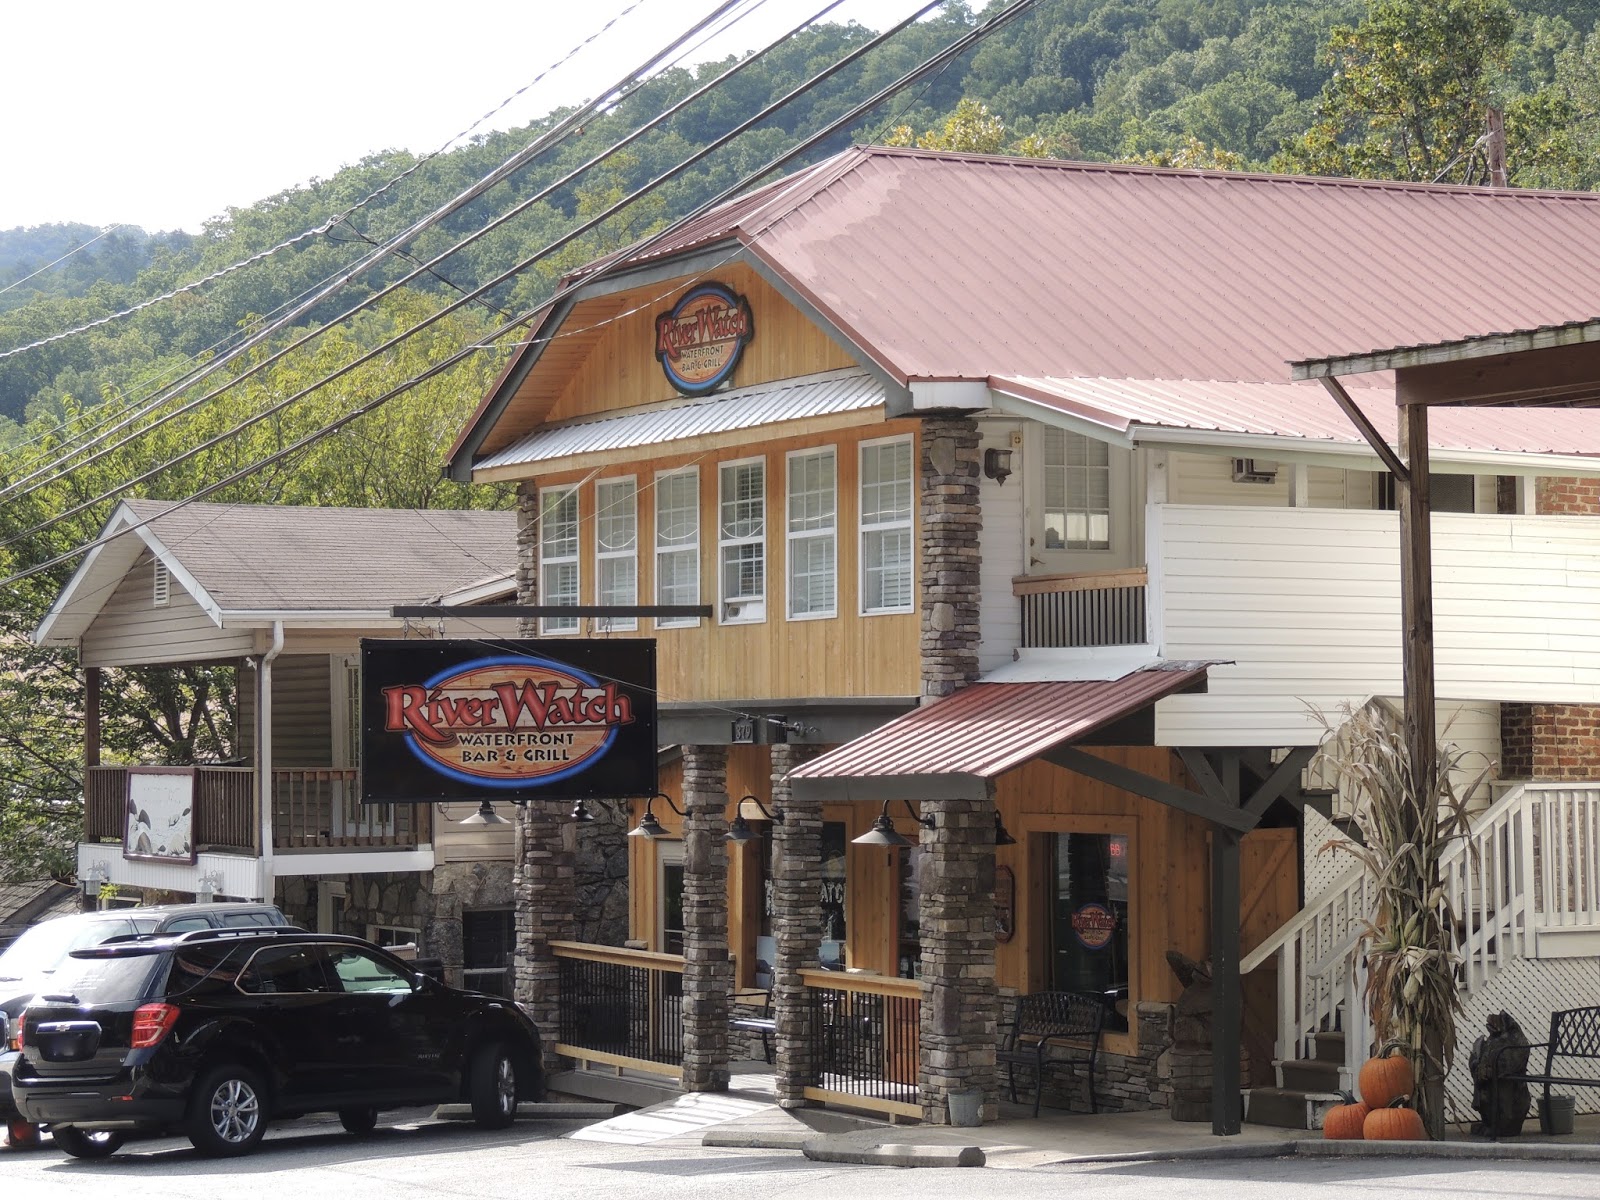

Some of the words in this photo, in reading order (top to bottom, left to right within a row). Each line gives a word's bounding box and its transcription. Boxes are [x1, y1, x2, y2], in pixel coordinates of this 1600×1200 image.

[681, 345, 724, 359] WATERFRONT
[681, 363, 695, 372] BAR
[703, 359, 721, 368] GRILL
[735, 726, 752, 739] 379
[458, 733, 574, 747] WATERFRONT
[462, 750, 498, 762] BAR
[500, 750, 516, 762] &
[523, 749, 570, 762] GRILL
